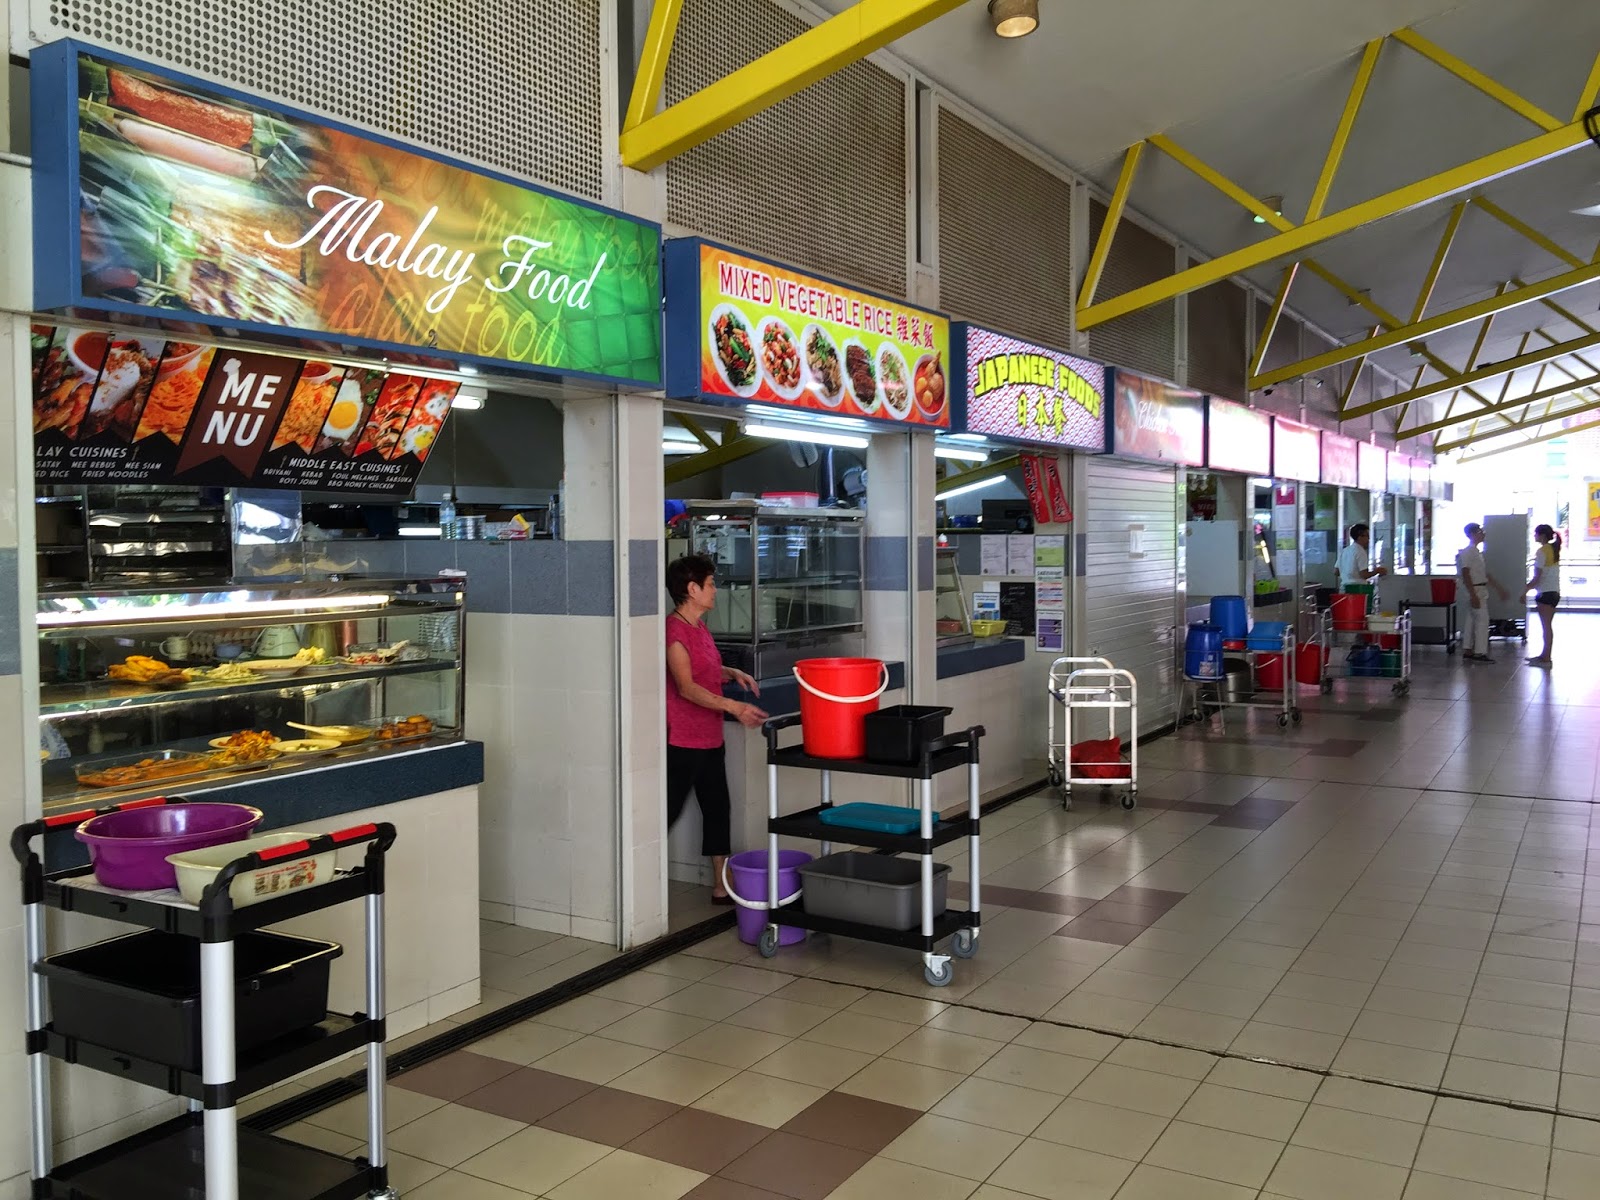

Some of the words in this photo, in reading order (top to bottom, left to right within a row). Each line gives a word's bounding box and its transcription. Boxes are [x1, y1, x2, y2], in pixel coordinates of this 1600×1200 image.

[263, 184, 476, 314] Malay
[485, 252, 608, 311] Food
[719, 262, 773, 305] MIXED
[777, 279, 861, 329] VEGETABLE
[864, 305, 893, 336] RICE
[427, 329, 438, 348] 2
[217, 370, 282, 409] ME
[974, 354, 1056, 398] JAPANESE
[1058, 363, 1102, 419] FOODS
[201, 410, 266, 447] NU
[36, 446, 63, 457] LAY
[69, 446, 128, 458] CUISINES
[34, 470, 47, 478] ED
[49, 470, 70, 478] RICE
[81, 470, 106, 478] FRIED
[107, 471, 149, 479] NOODLES
[35, 461, 62, 469] SATAY
[71, 461, 87, 469] MEE
[90, 461, 116, 469] REBUS
[124, 462, 140, 470] MEE
[142, 462, 162, 470] SIAM
[288, 457, 328, 469] MIDDLE
[329, 460, 356, 471] EAST
[359, 462, 402, 474] CUISINES
[300, 470, 324, 479] KEBAB
[299, 478, 319, 486] JOHN
[345, 481, 367, 489] HONEY
[368, 482, 396, 490] CHICKEN
